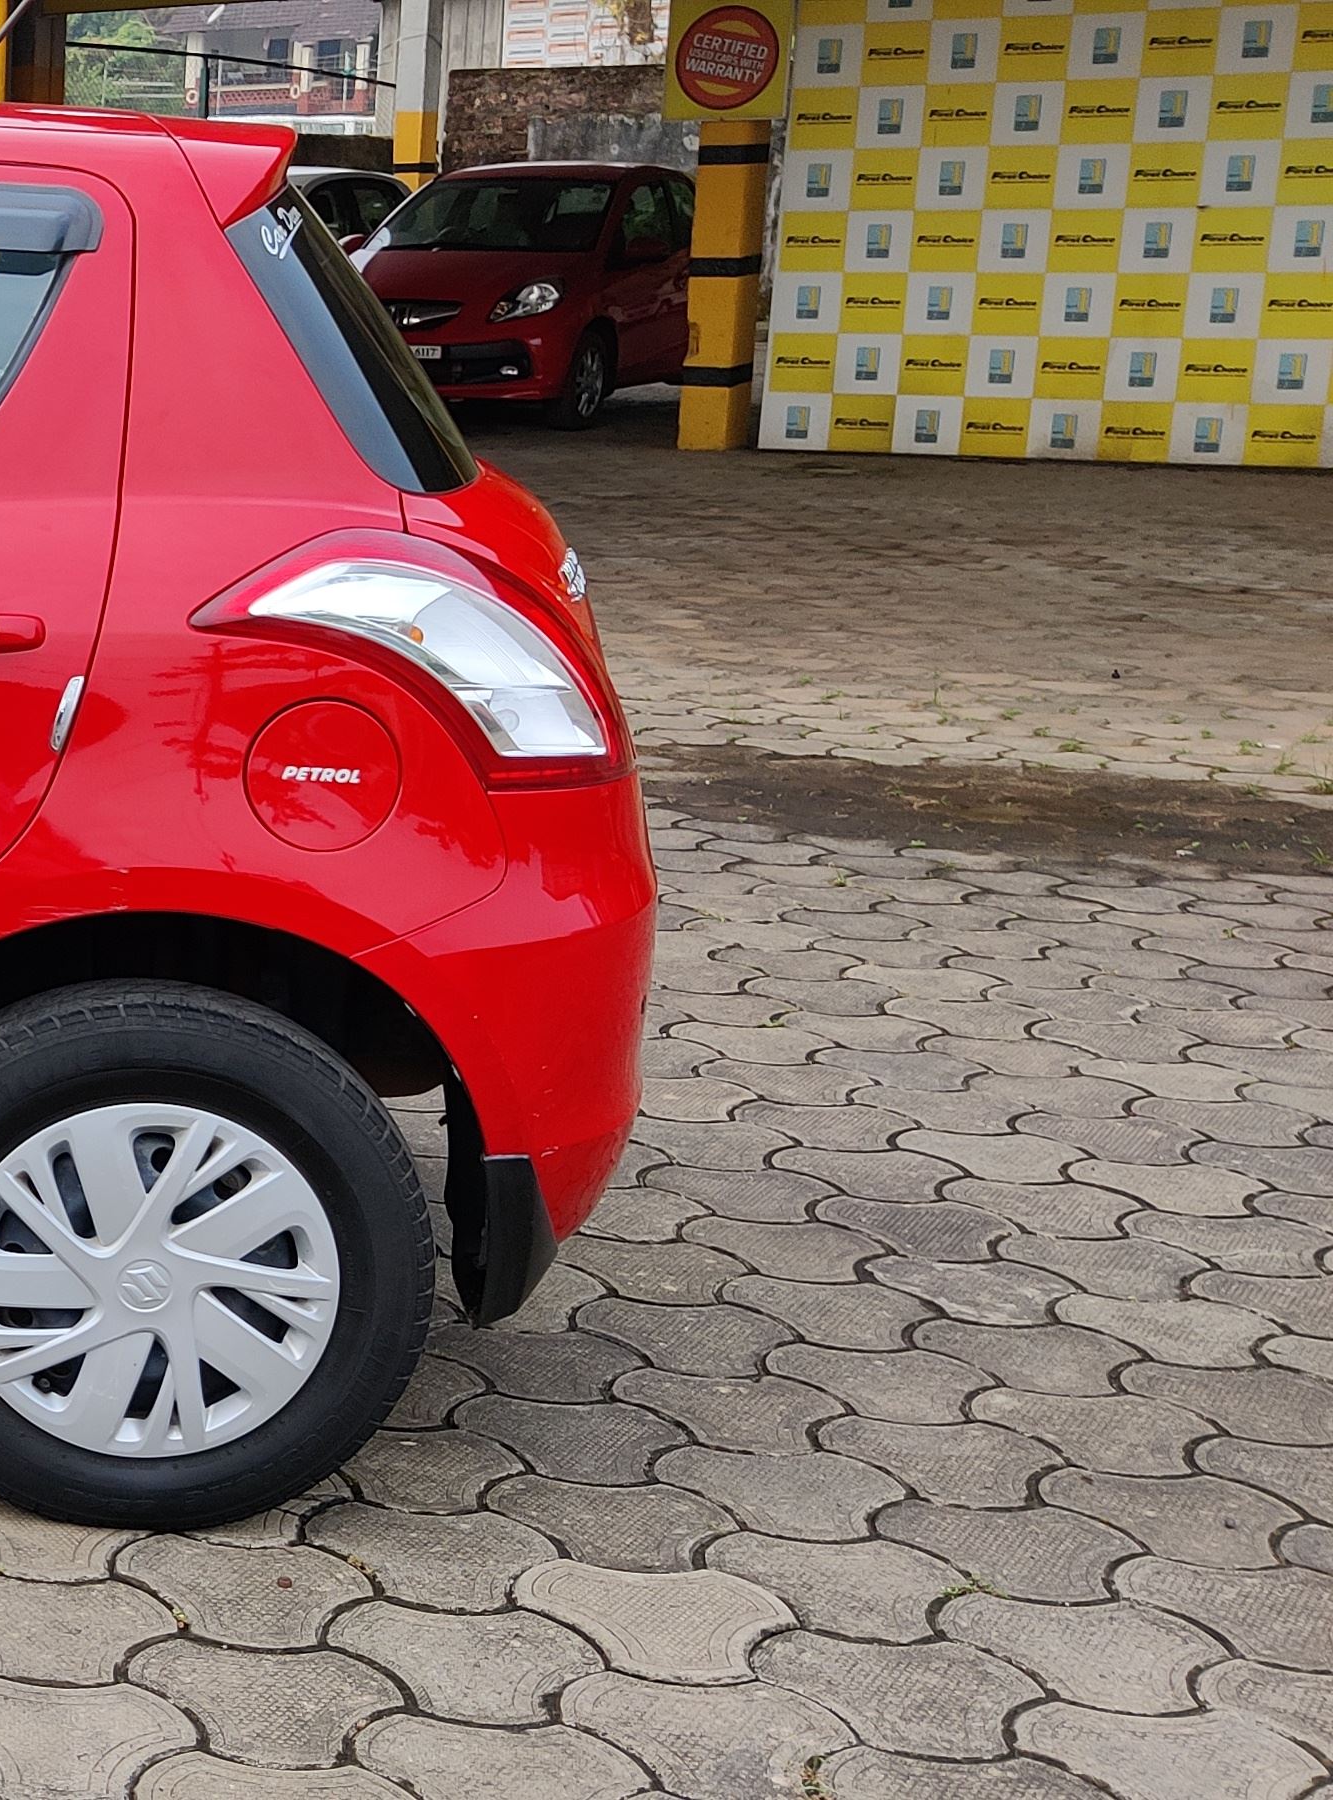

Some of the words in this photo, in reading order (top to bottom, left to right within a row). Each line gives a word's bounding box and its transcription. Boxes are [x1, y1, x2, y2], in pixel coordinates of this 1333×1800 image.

[693, 33, 768, 60] CERTIFIED
[685, 57, 762, 84] WARRANTY
[689, 48, 714, 61] USED
[715, 51, 739, 66] CARS
[740, 58, 765, 71] WITH
[281, 765, 361, 784] PETROL
